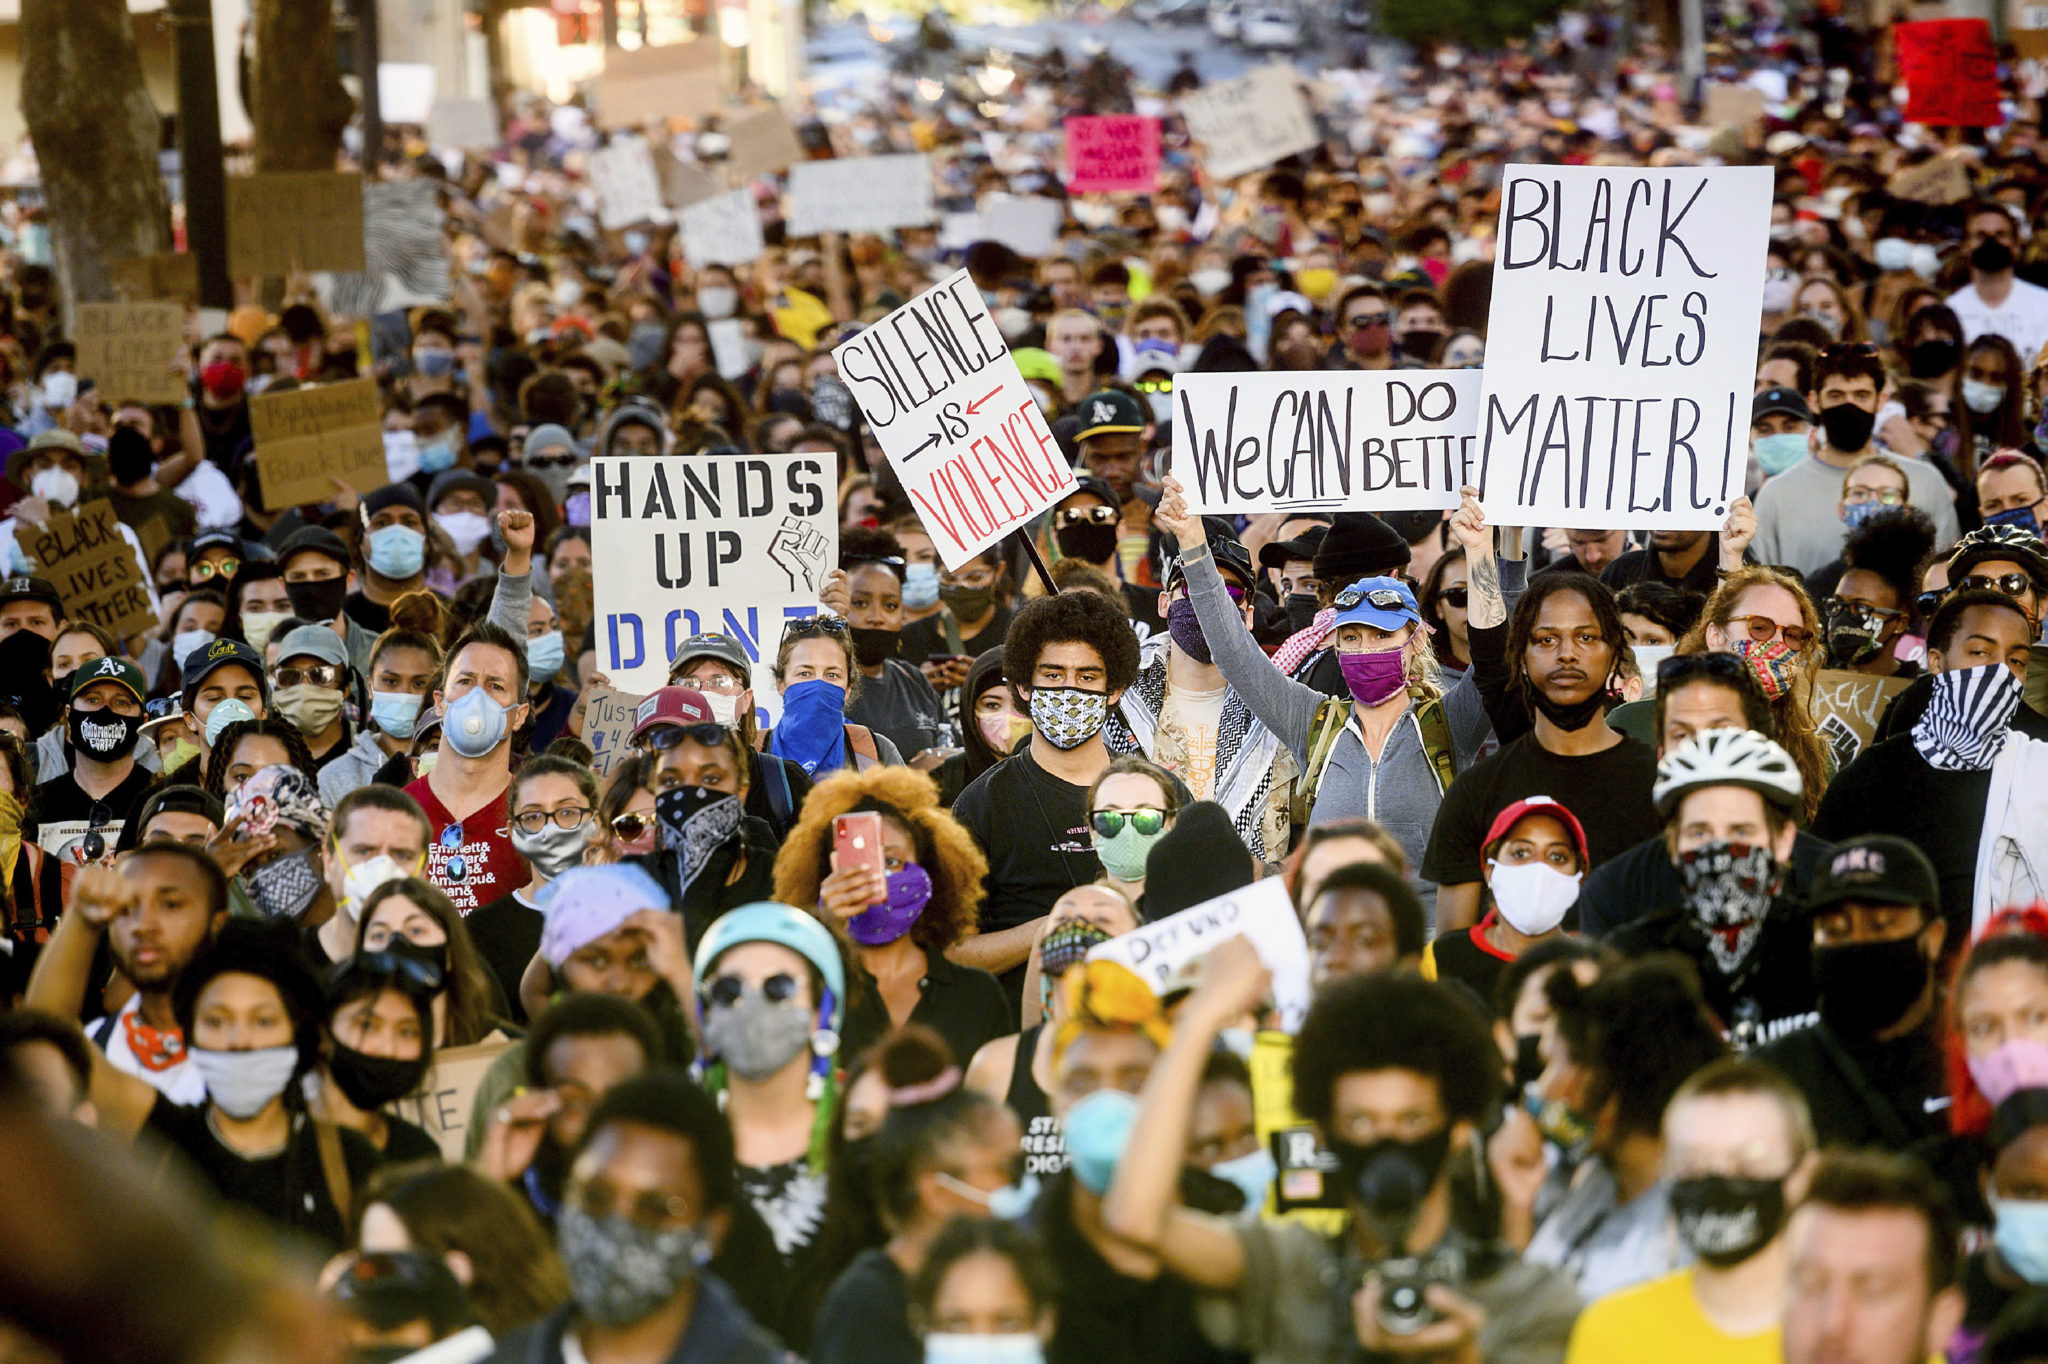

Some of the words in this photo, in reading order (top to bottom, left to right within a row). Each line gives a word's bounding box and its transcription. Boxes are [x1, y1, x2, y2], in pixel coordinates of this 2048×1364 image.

[1504, 178, 1717, 278] BLACK
[842, 275, 1006, 427] SILENCE
[1541, 291, 1707, 368] LIVES
[936, 402, 969, 445] IS
[1386, 381, 1457, 427] DO
[910, 400, 1073, 552] VIOLENCE
[1478, 392, 1735, 516] MATTER!
[595, 459, 824, 522] HANDS
[35, 511, 116, 568] BLACK
[654, 530, 742, 589] UP
[62, 555, 129, 602] IVES
[74, 586, 147, 629] ATTER
[94, 657, 126, 677] A's
[1813, 681, 1871, 719] ACK
[428, 852, 489, 866] Mear&
[428, 863, 483, 876] Jas&
[430, 872, 496, 887] Amou&
